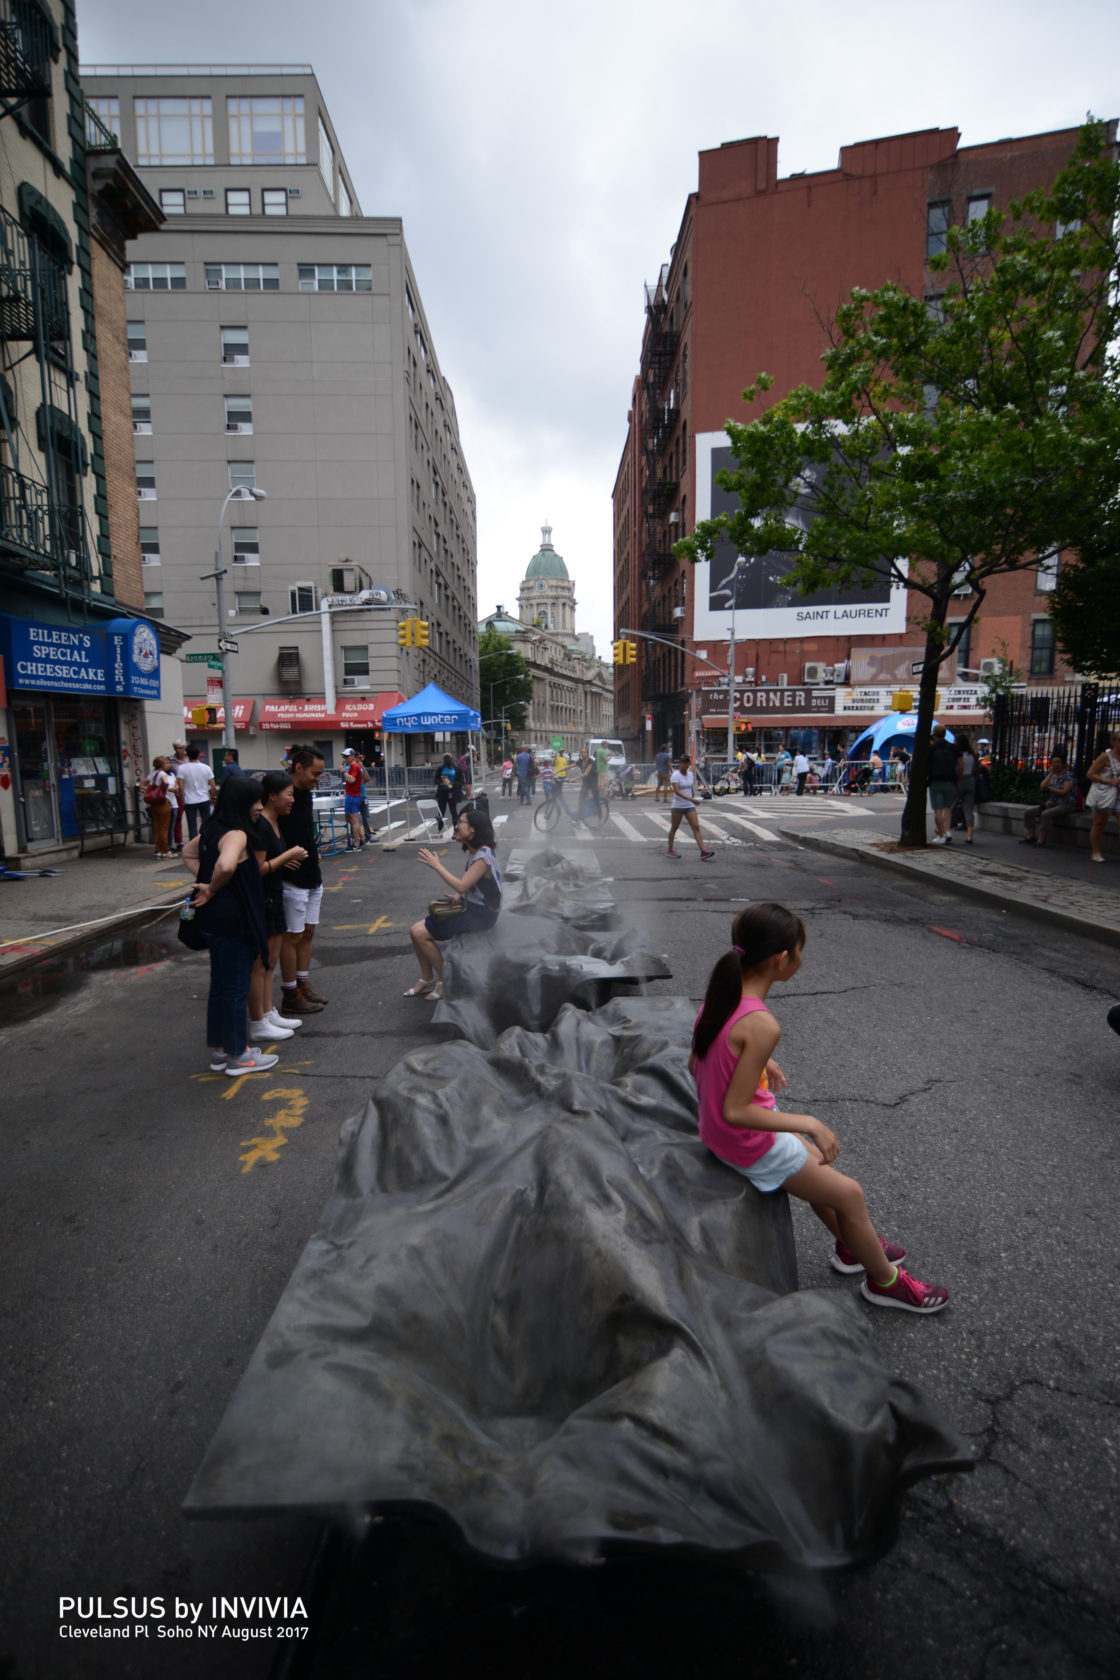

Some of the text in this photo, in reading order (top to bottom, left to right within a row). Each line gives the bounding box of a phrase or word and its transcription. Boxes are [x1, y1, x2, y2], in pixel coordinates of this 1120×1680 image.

[796, 608, 890, 621] SAINT LAURENT
[29, 627, 91, 648] EILEEN'S
[33, 645, 89, 663] SPECIAL
[17, 661, 105, 681] CHEESECAKE
[18, 678, 106, 691] www.eileenscheesecake.com
[345, 703, 375, 711] KABOB
[709, 690, 829, 708] the CORNER DELI
[396, 715, 418, 728] nyc
[421, 714, 458, 725] water
